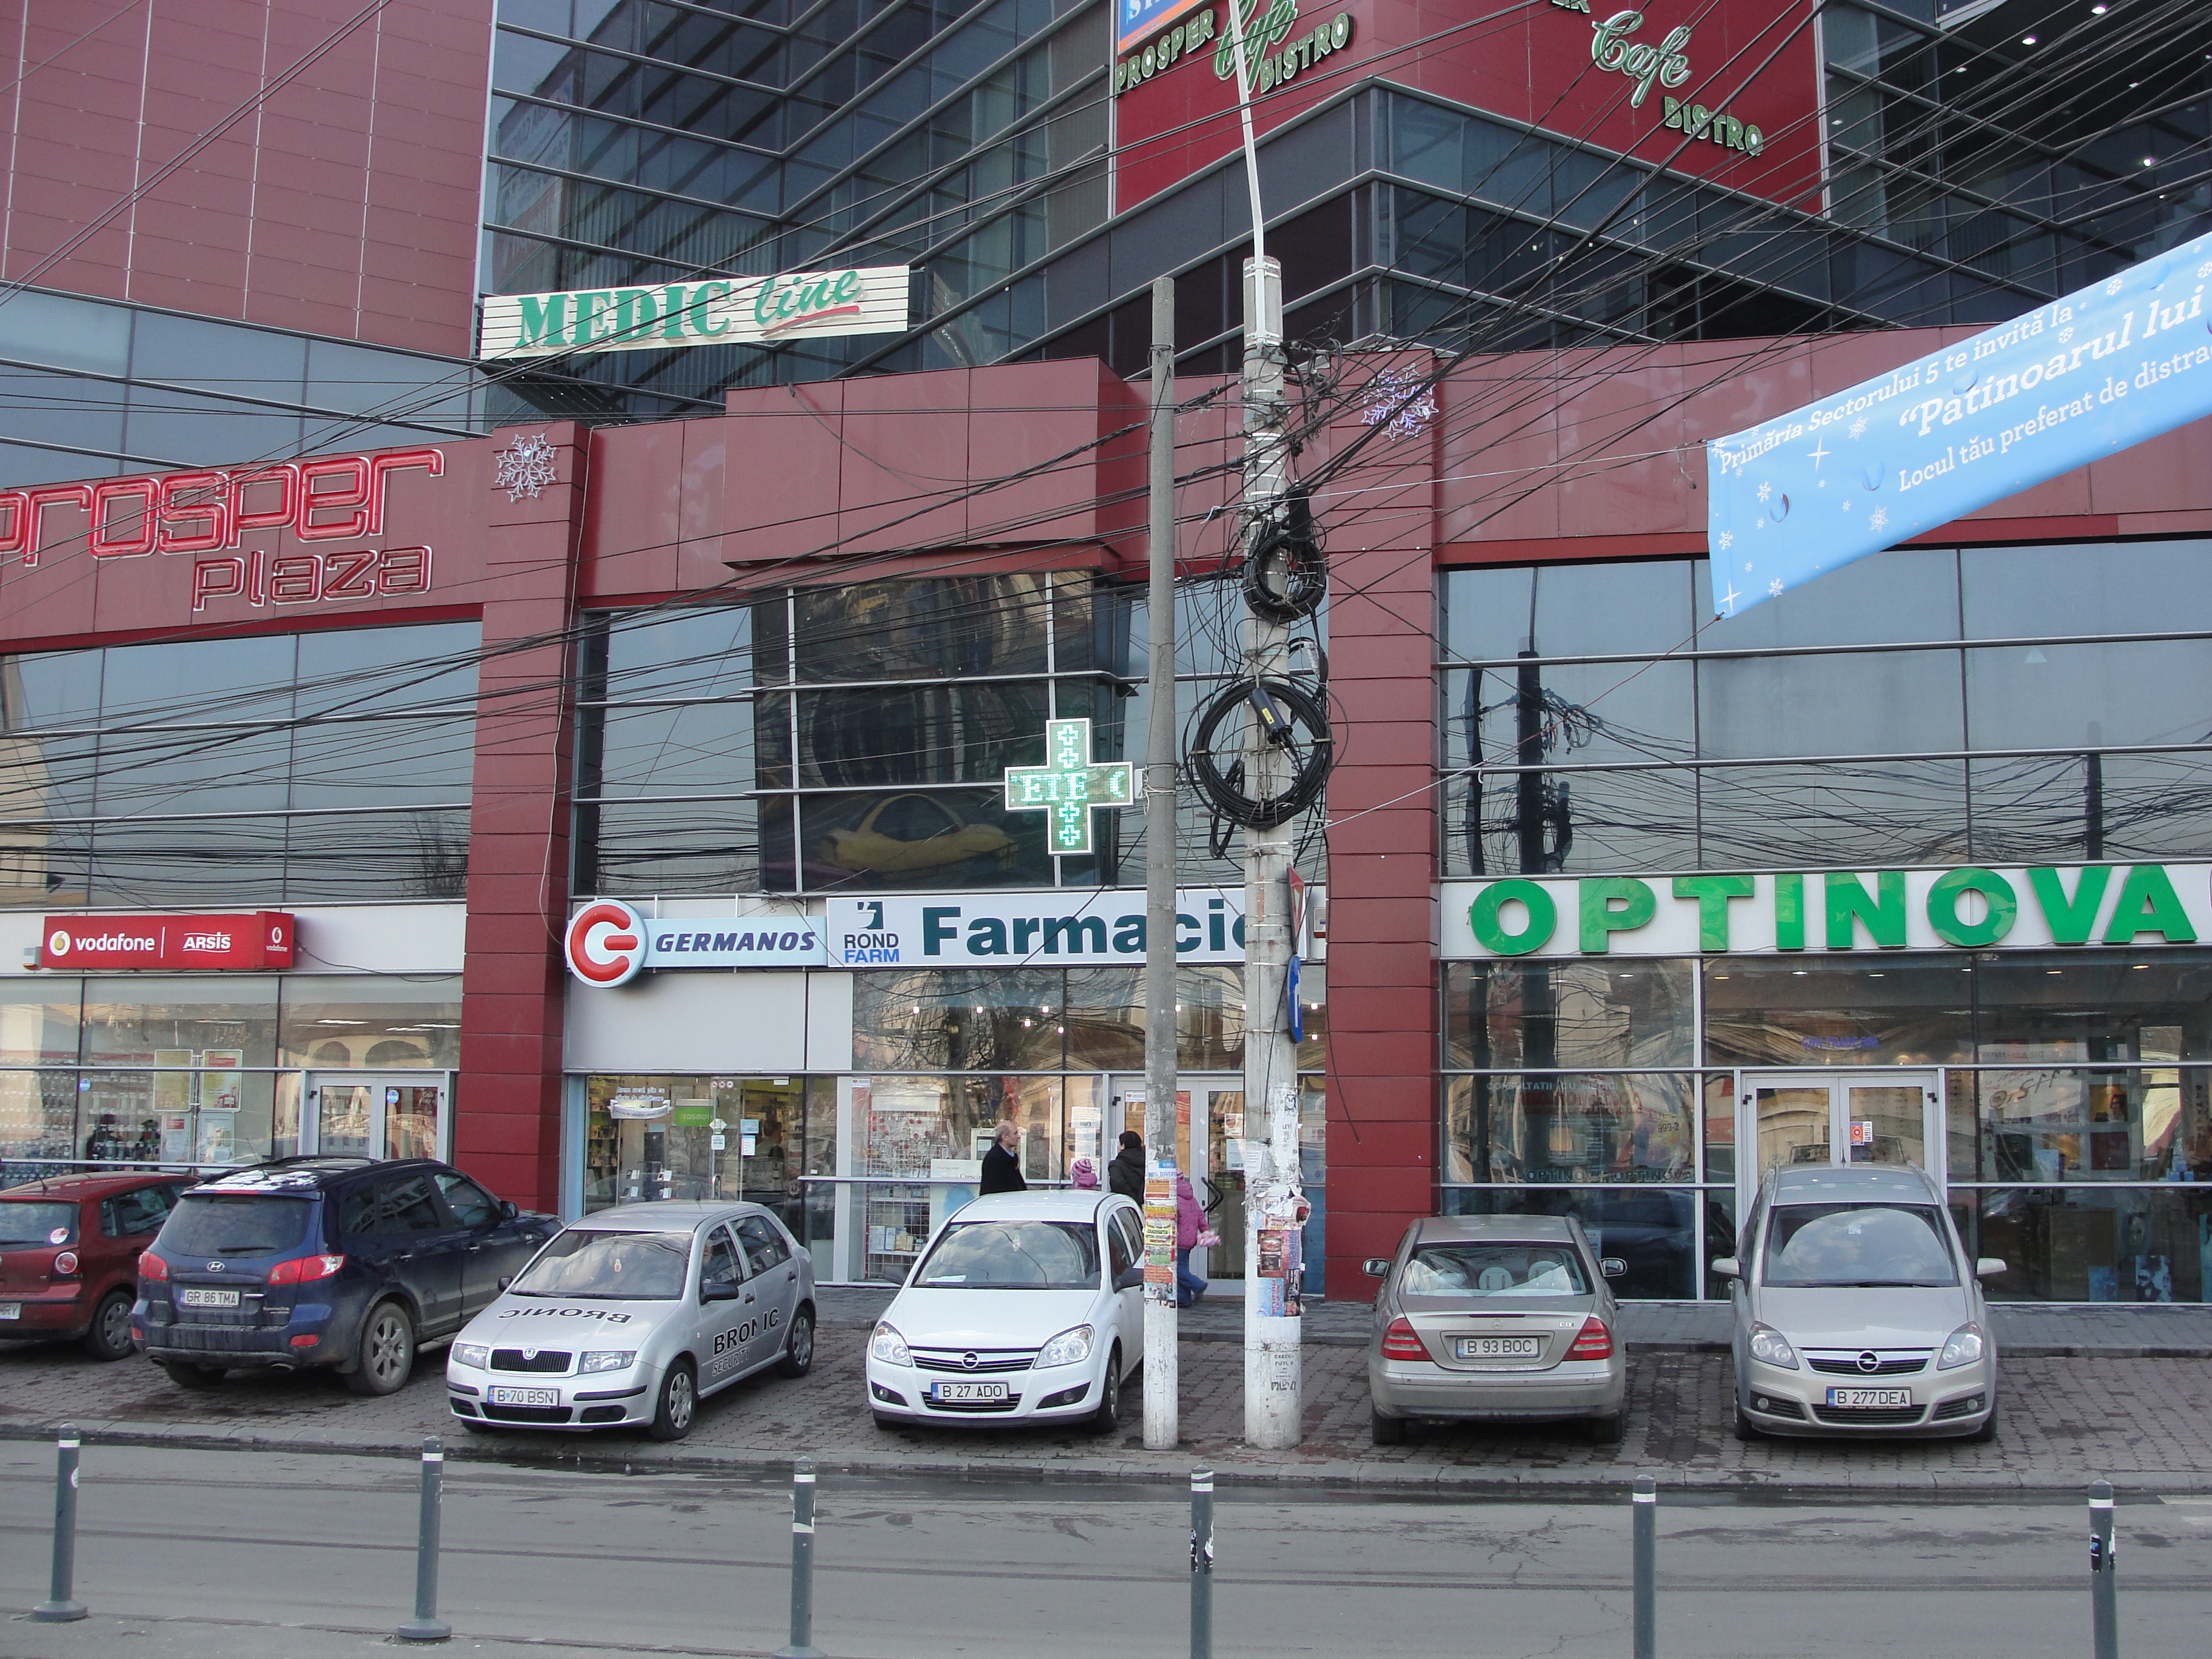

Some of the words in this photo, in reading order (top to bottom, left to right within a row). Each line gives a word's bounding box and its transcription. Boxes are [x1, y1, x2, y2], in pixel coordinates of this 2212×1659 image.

[1114, 9, 1215, 95] PROSPER
[1259, 13, 1350, 94] BISTRO
[1591, 10, 1693, 109] Cafe
[1663, 96, 1764, 157] BISTRO
[515, 280, 736, 350] MEDIC
[754, 270, 865, 326] line
[2142, 284, 2205, 340] lui
[1720, 423, 1803, 475] Primăria
[1808, 367, 1920, 432] Sectorului
[1925, 361, 1939, 384] 5
[1945, 351, 1968, 373] te
[1972, 311, 2045, 362] invită
[2049, 304, 2073, 328] la
[1899, 447, 1956, 492] Locul
[1959, 435, 1995, 463] tău
[2000, 391, 2094, 454] preferat
[2099, 377, 2128, 404] de
[193, 546, 432, 612] plaza
[1471, 865, 2198, 956] OPTINOVA
[75, 933, 155, 951] vodafone
[656, 931, 816, 953] GERMANOS
[844, 933, 899, 949] ROND
[844, 948, 900, 963] FARM
[186, 1290, 202, 1304] GR
[204, 1290, 216, 1304] 86
[218, 1290, 238, 1304] TMA
[1467, 1340, 1477, 1353] B
[1483, 1339, 1499, 1353] 93
[1502, 1339, 1532, 1353] BOC
[497, 1389, 506, 1402] B
[510, 1390, 524, 1403] 70
[528, 1390, 554, 1404] BSN
[942, 1385, 952, 1398] B
[956, 1384, 970, 1397] 27
[976, 1384, 1002, 1397] ADO
[1837, 1391, 1847, 1404] B
[1852, 1391, 1877, 1404] 277
[1879, 1391, 1907, 1404] DEA
